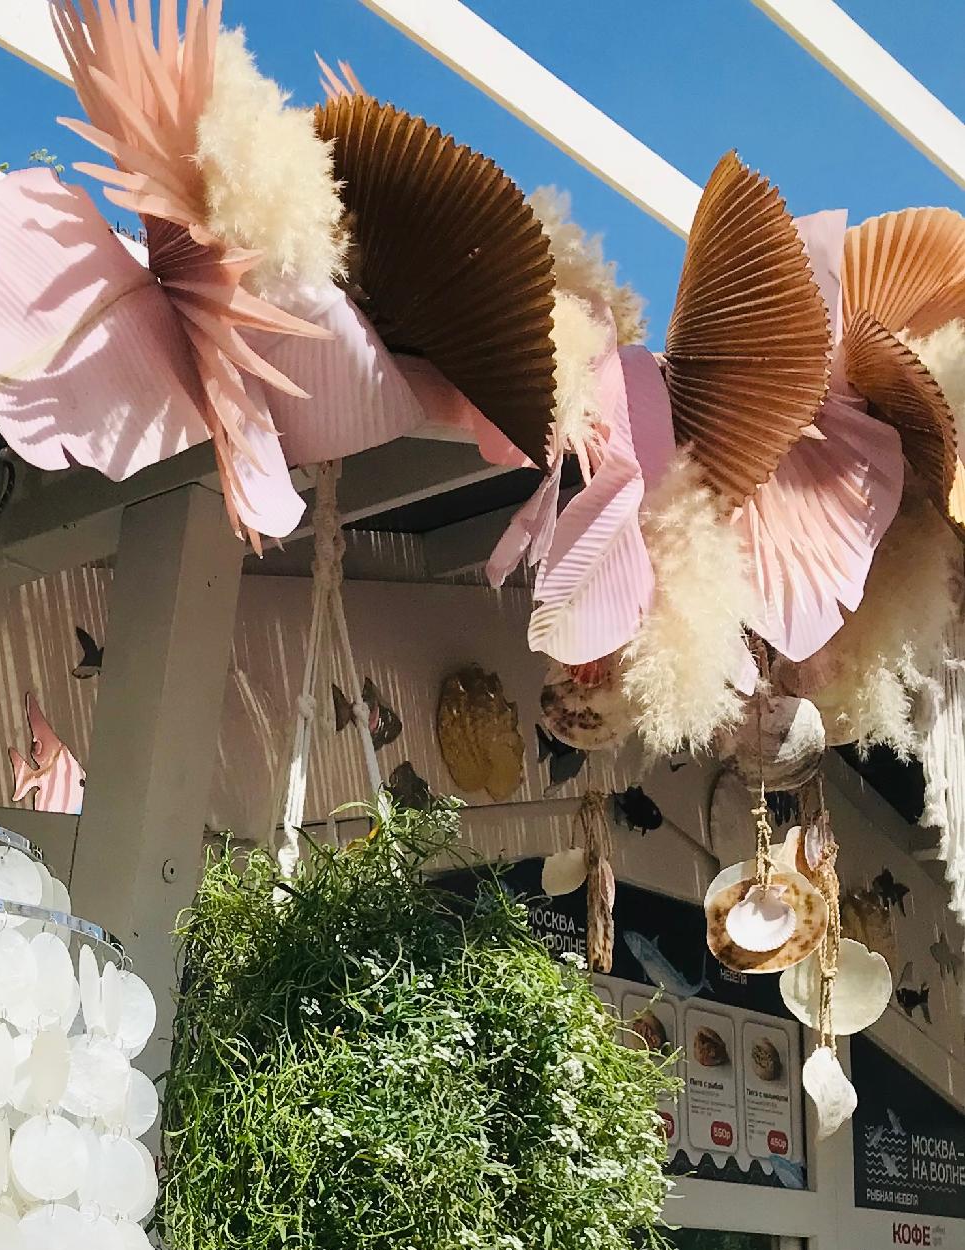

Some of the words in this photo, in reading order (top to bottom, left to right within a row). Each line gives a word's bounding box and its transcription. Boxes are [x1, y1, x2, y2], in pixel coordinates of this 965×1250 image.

[911, 1134, 957, 1162] МОСКВА
[912, 1160, 928, 1181] НА
[892, 1222, 931, 1247] КОФЕ
